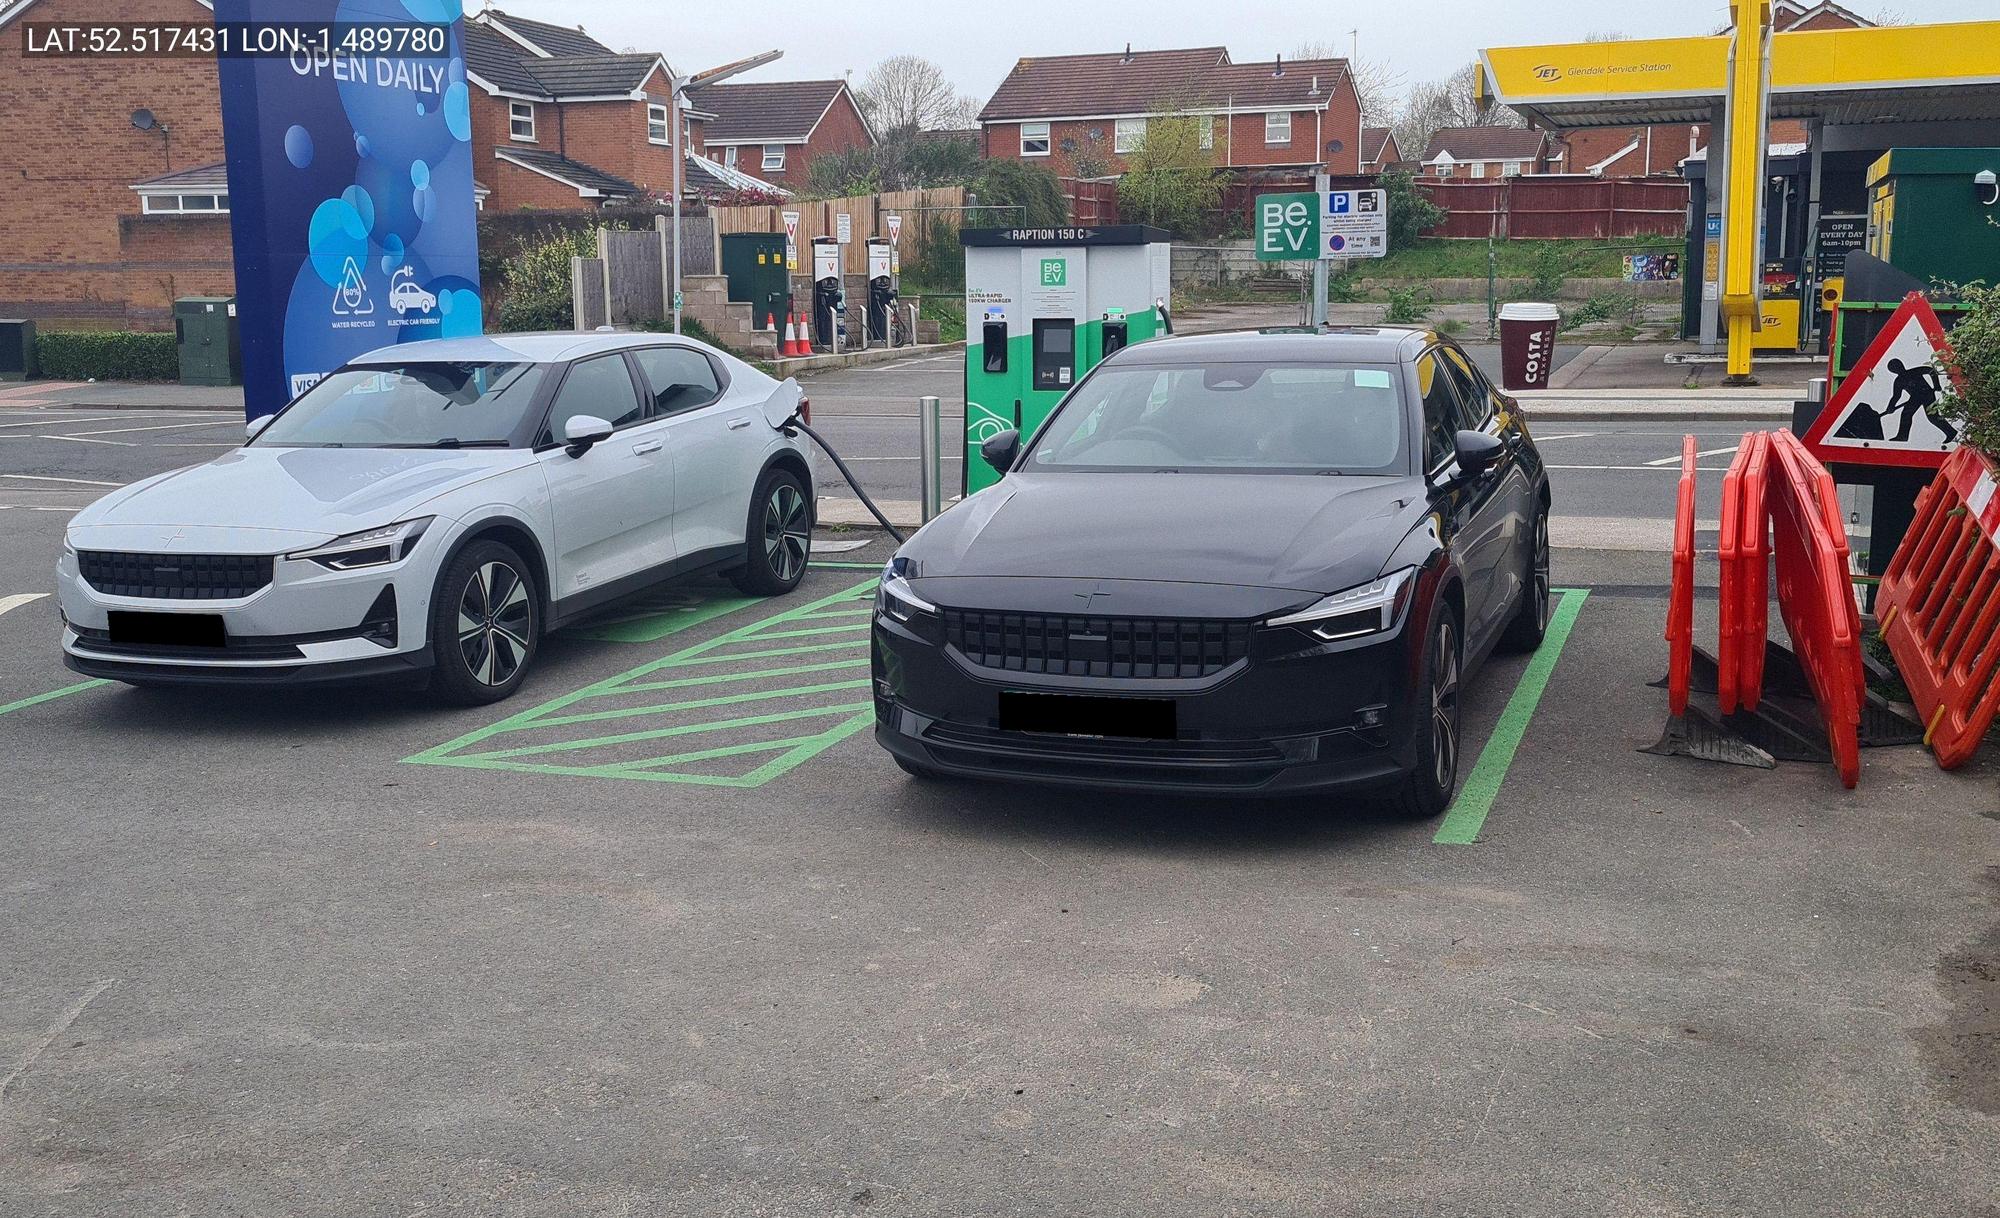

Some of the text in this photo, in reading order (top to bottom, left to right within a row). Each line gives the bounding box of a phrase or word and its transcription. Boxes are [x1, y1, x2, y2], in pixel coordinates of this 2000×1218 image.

[290, 43, 444, 94] OPEN DAILY
[1536, 63, 1672, 79] JET Glendale Service Station
[1263, 201, 1312, 227] Be.
[1334, 195, 1347, 212] P
[1012, 228, 1084, 240] RAPTION 150 C
[1263, 227, 1308, 252] EV
[1044, 273, 1062, 283] EV
[350, 320, 376, 328] RECYCLED
[1525, 331, 1542, 383] COSTA
[1540, 330, 1551, 375] EXPRESS
